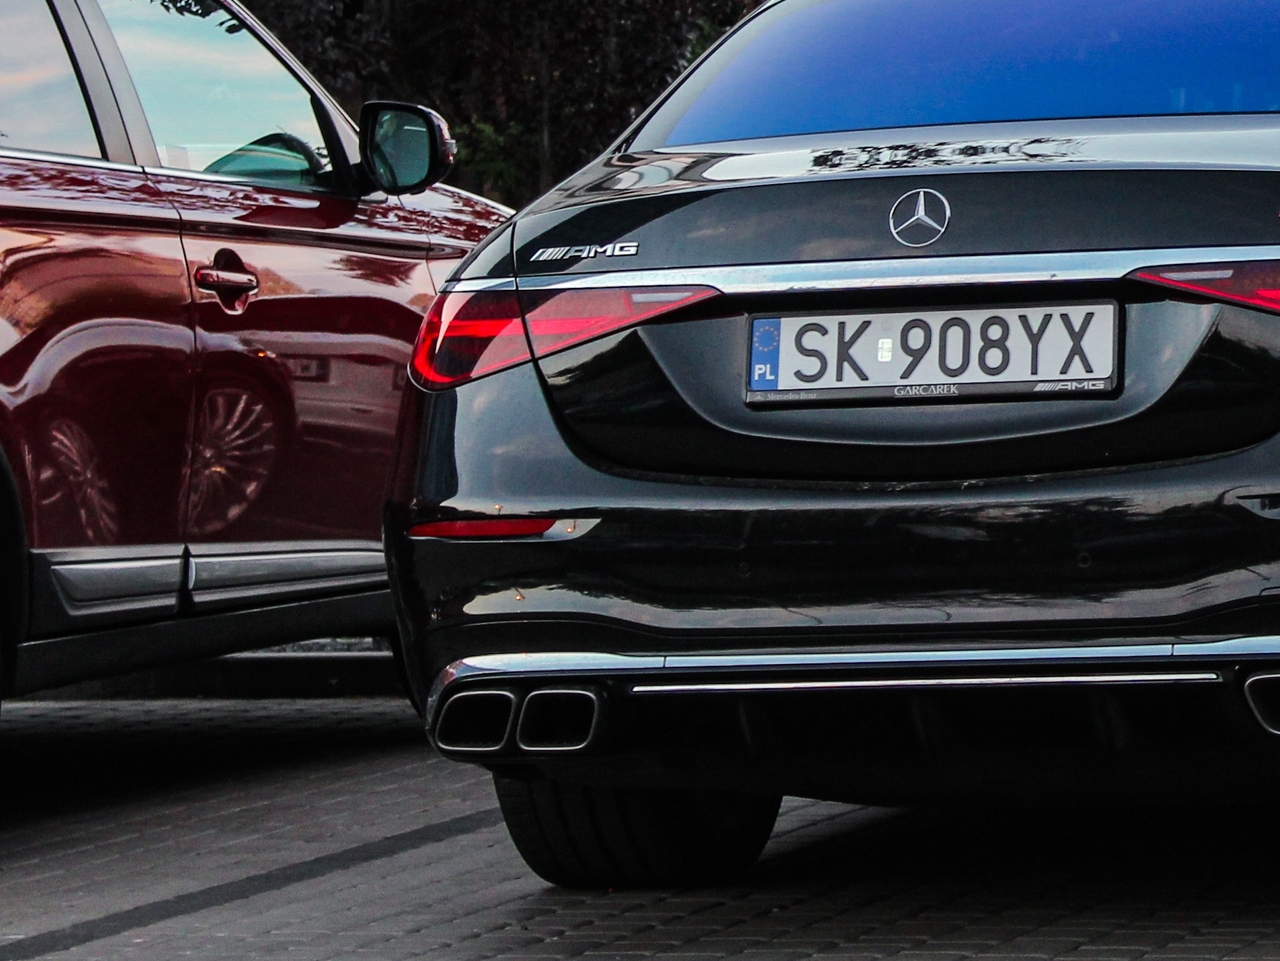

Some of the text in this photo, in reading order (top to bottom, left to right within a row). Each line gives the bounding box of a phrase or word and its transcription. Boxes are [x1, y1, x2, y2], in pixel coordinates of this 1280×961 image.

[563, 242, 639, 259] AMG
[794, 312, 1095, 382] SK 908YX
[754, 364, 775, 380] PL
[894, 384, 959, 397] GARCAREK
[1055, 381, 1104, 390] AMG
